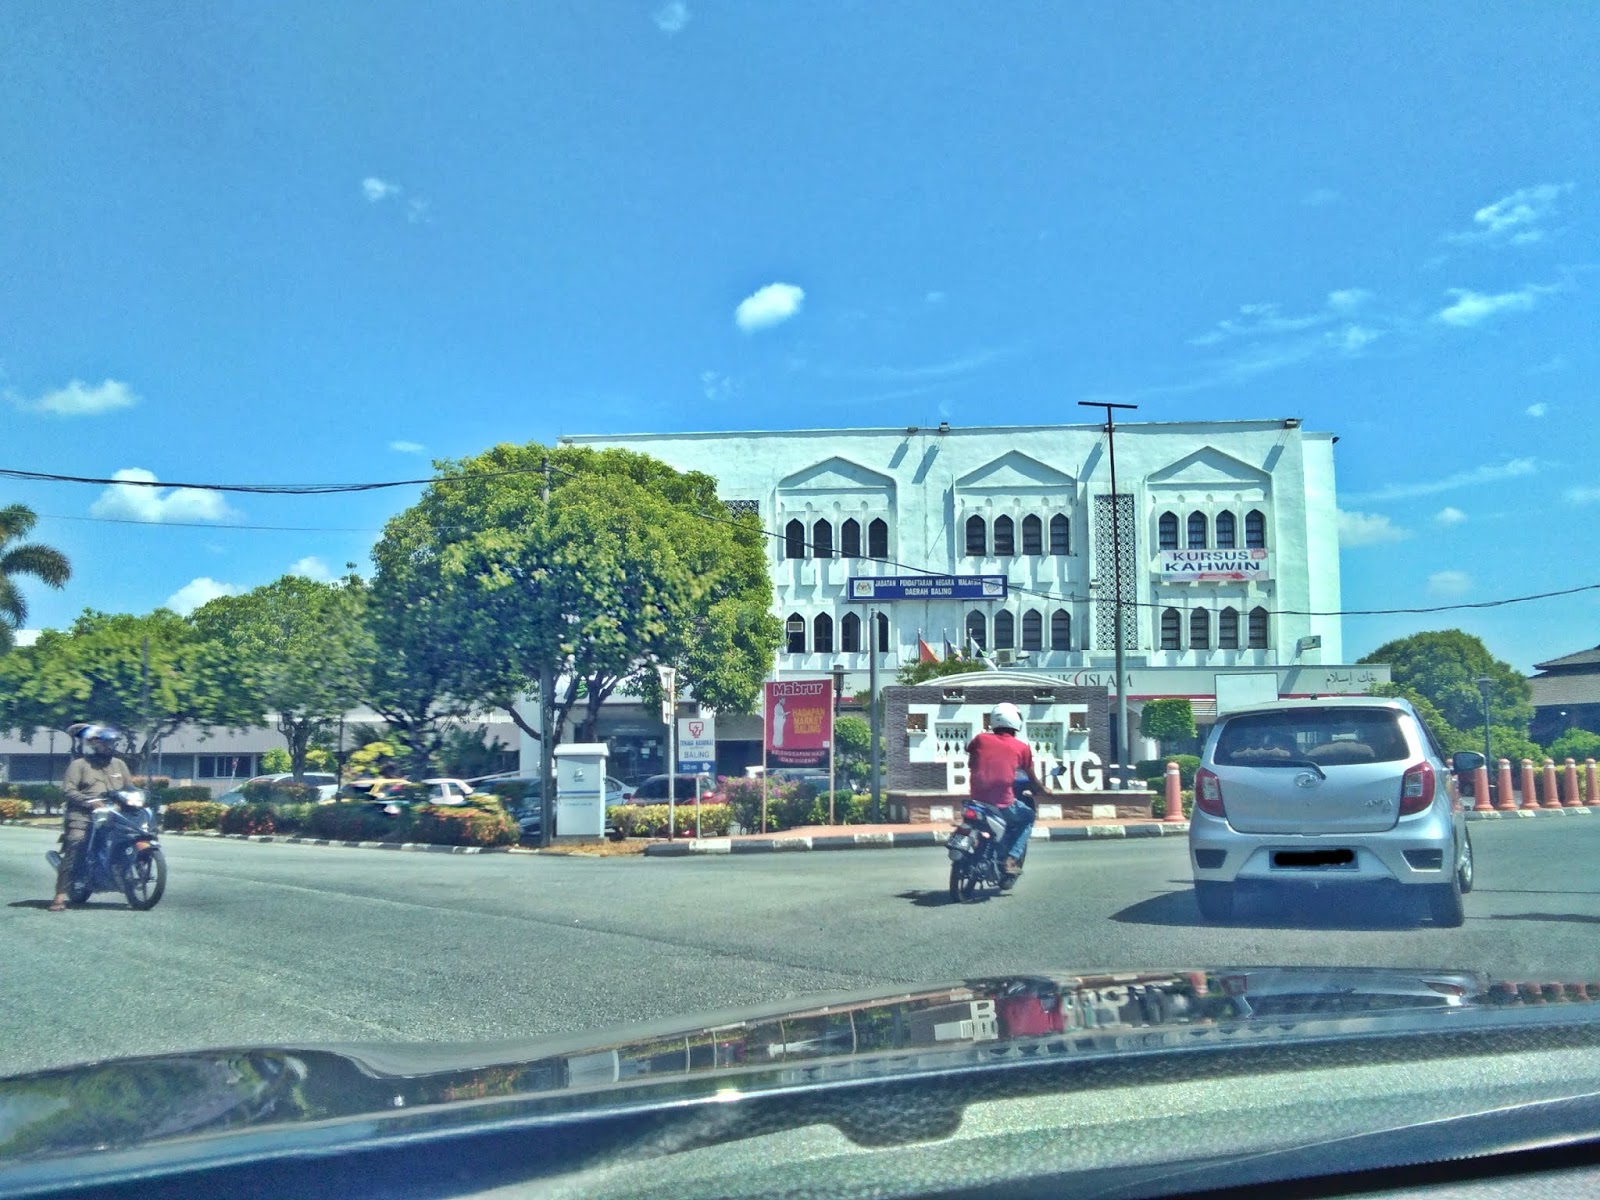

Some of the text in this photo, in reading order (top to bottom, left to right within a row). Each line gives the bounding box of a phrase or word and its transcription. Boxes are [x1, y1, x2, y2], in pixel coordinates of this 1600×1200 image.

[1172, 551, 1249, 561] KURSUS
[1165, 561, 1260, 572] KAHWIN
[899, 578, 933, 587] PENDAFTARAN
[935, 578, 955, 587] NEGARA
[904, 587, 953, 596] DAERAH BALING
[773, 682, 823, 696] Mabrur
[794, 724, 821, 733] BALING
[684, 751, 710, 759] BALING
[946, 751, 1104, 792] BING
